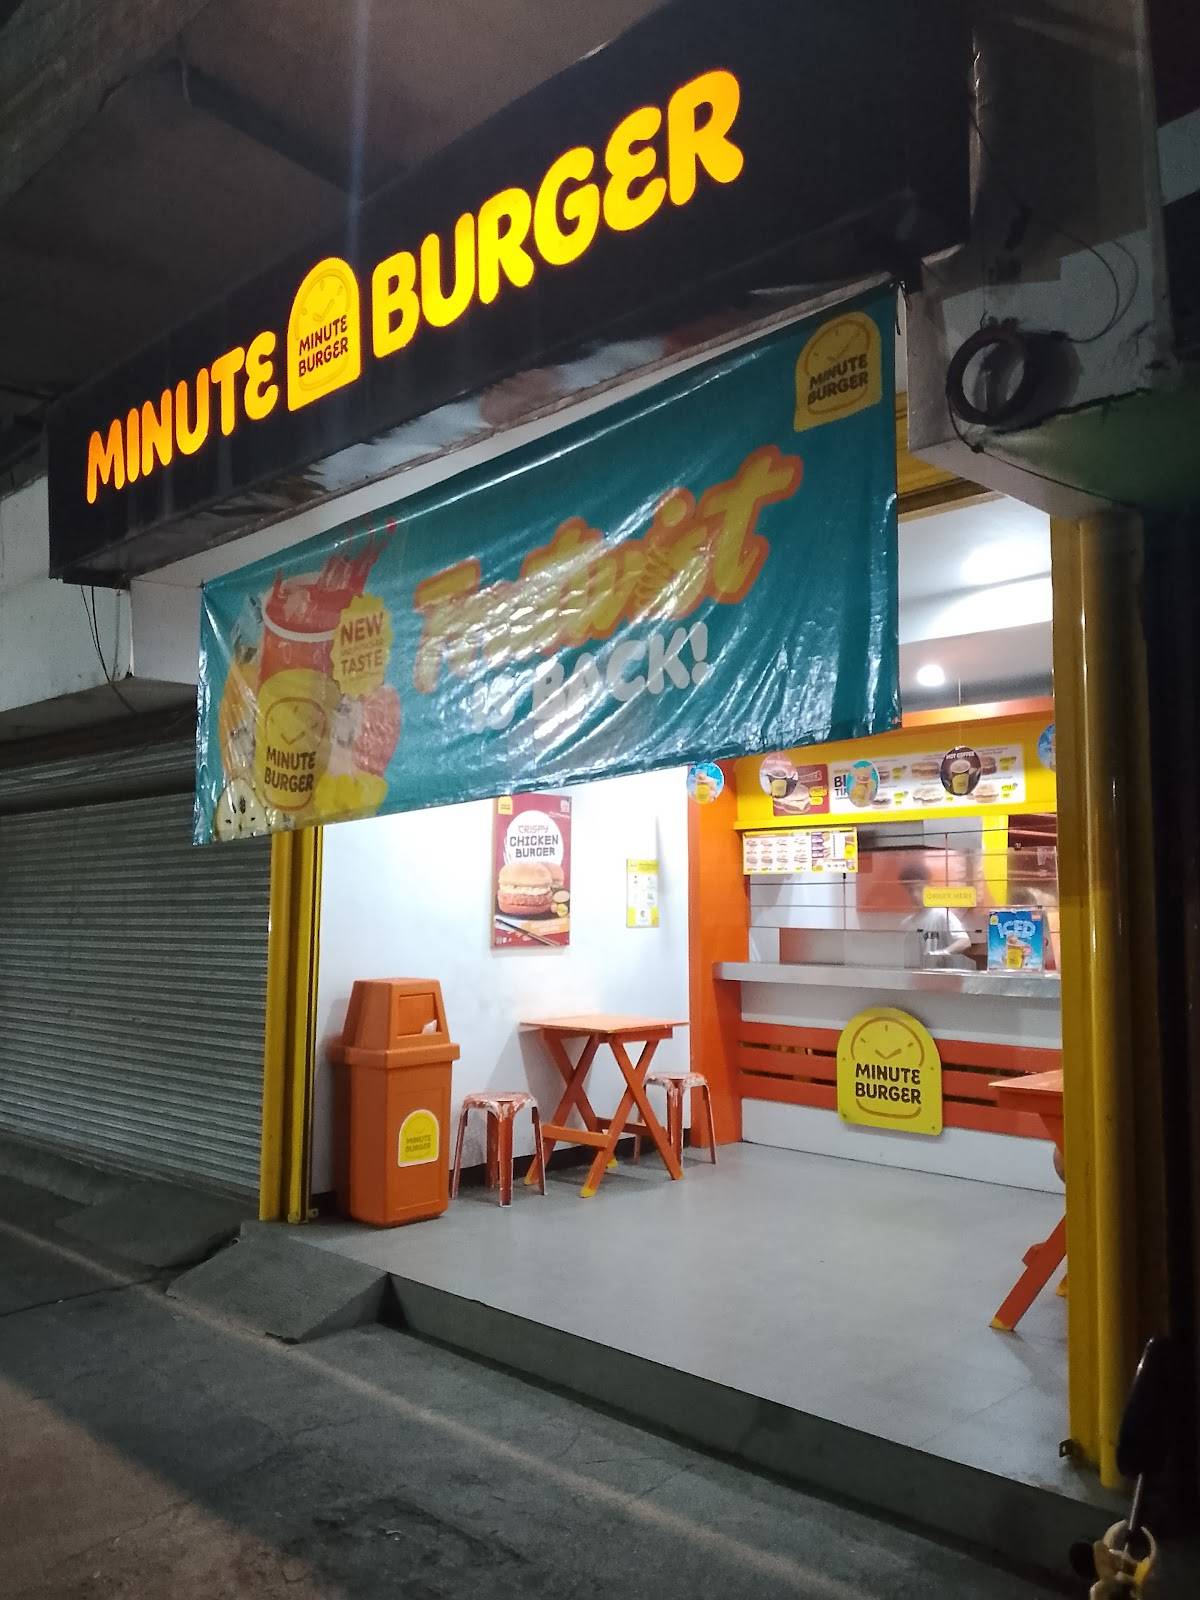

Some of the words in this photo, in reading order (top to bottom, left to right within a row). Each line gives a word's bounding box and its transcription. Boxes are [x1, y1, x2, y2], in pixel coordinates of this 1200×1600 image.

[87, 331, 279, 504] MINUTE
[372, 70, 744, 358] BURGER
[299, 315, 348, 356] MINUTE
[298, 337, 348, 378] BURGER
[809, 354, 868, 390] MINUTE
[807, 371, 869, 406] BURGER
[341, 611, 384, 647] NEW
[341, 648, 384, 676] TASTE
[533, 621, 709, 720] BACK!
[266, 745, 316, 770] MINUTE
[264, 766, 314, 793] BURGER
[834, 774, 847, 788] BI
[509, 834, 559, 848] CHICKEN
[515, 846, 556, 858] BURGER
[855, 1062, 921, 1085] MINUTE
[855, 1081, 922, 1105] BURGER
